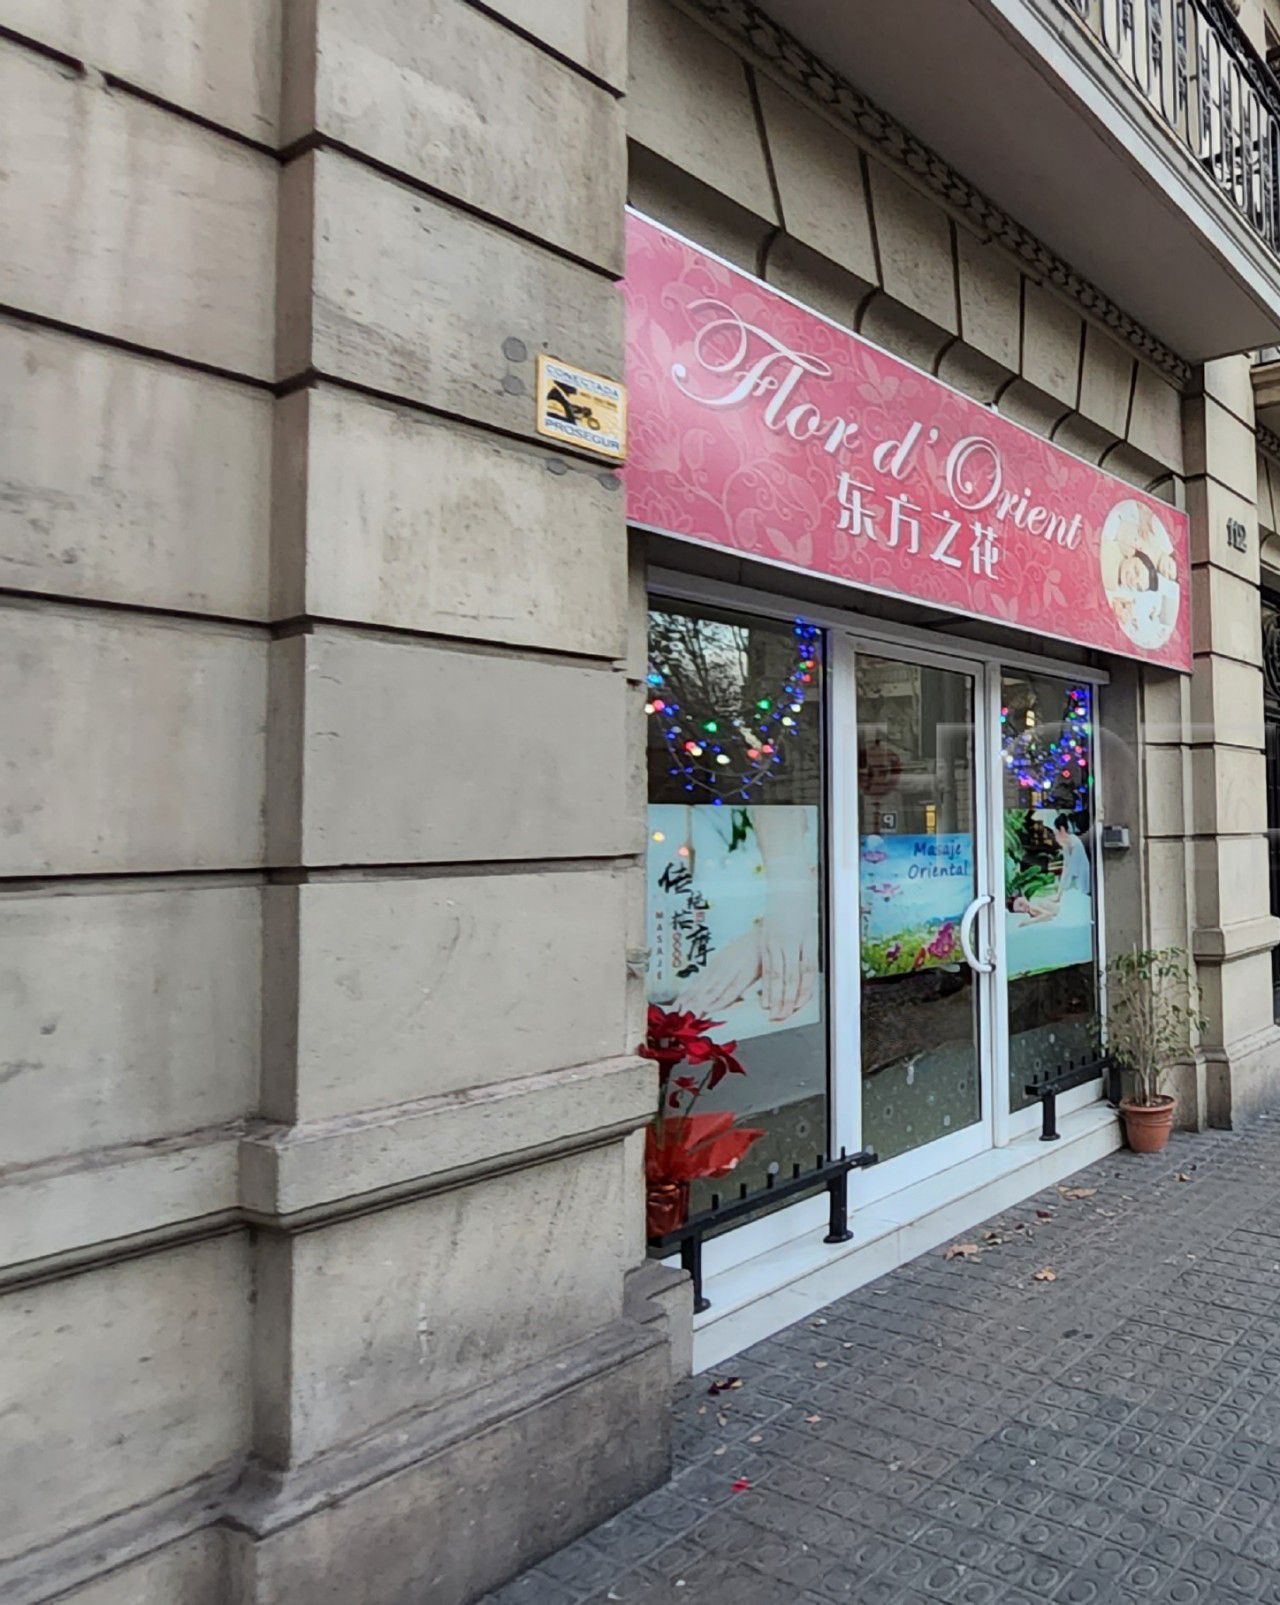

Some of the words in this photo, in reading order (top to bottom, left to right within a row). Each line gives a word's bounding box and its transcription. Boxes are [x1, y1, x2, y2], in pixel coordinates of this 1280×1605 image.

[671, 299, 860, 453] Flor
[544, 418, 620, 450] PROSEGUR
[836, 471, 999, 580] 东方之花
[1226, 517, 1247, 554] 112
[913, 840, 962, 860] Masaje
[907, 860, 969, 880] Oriental
